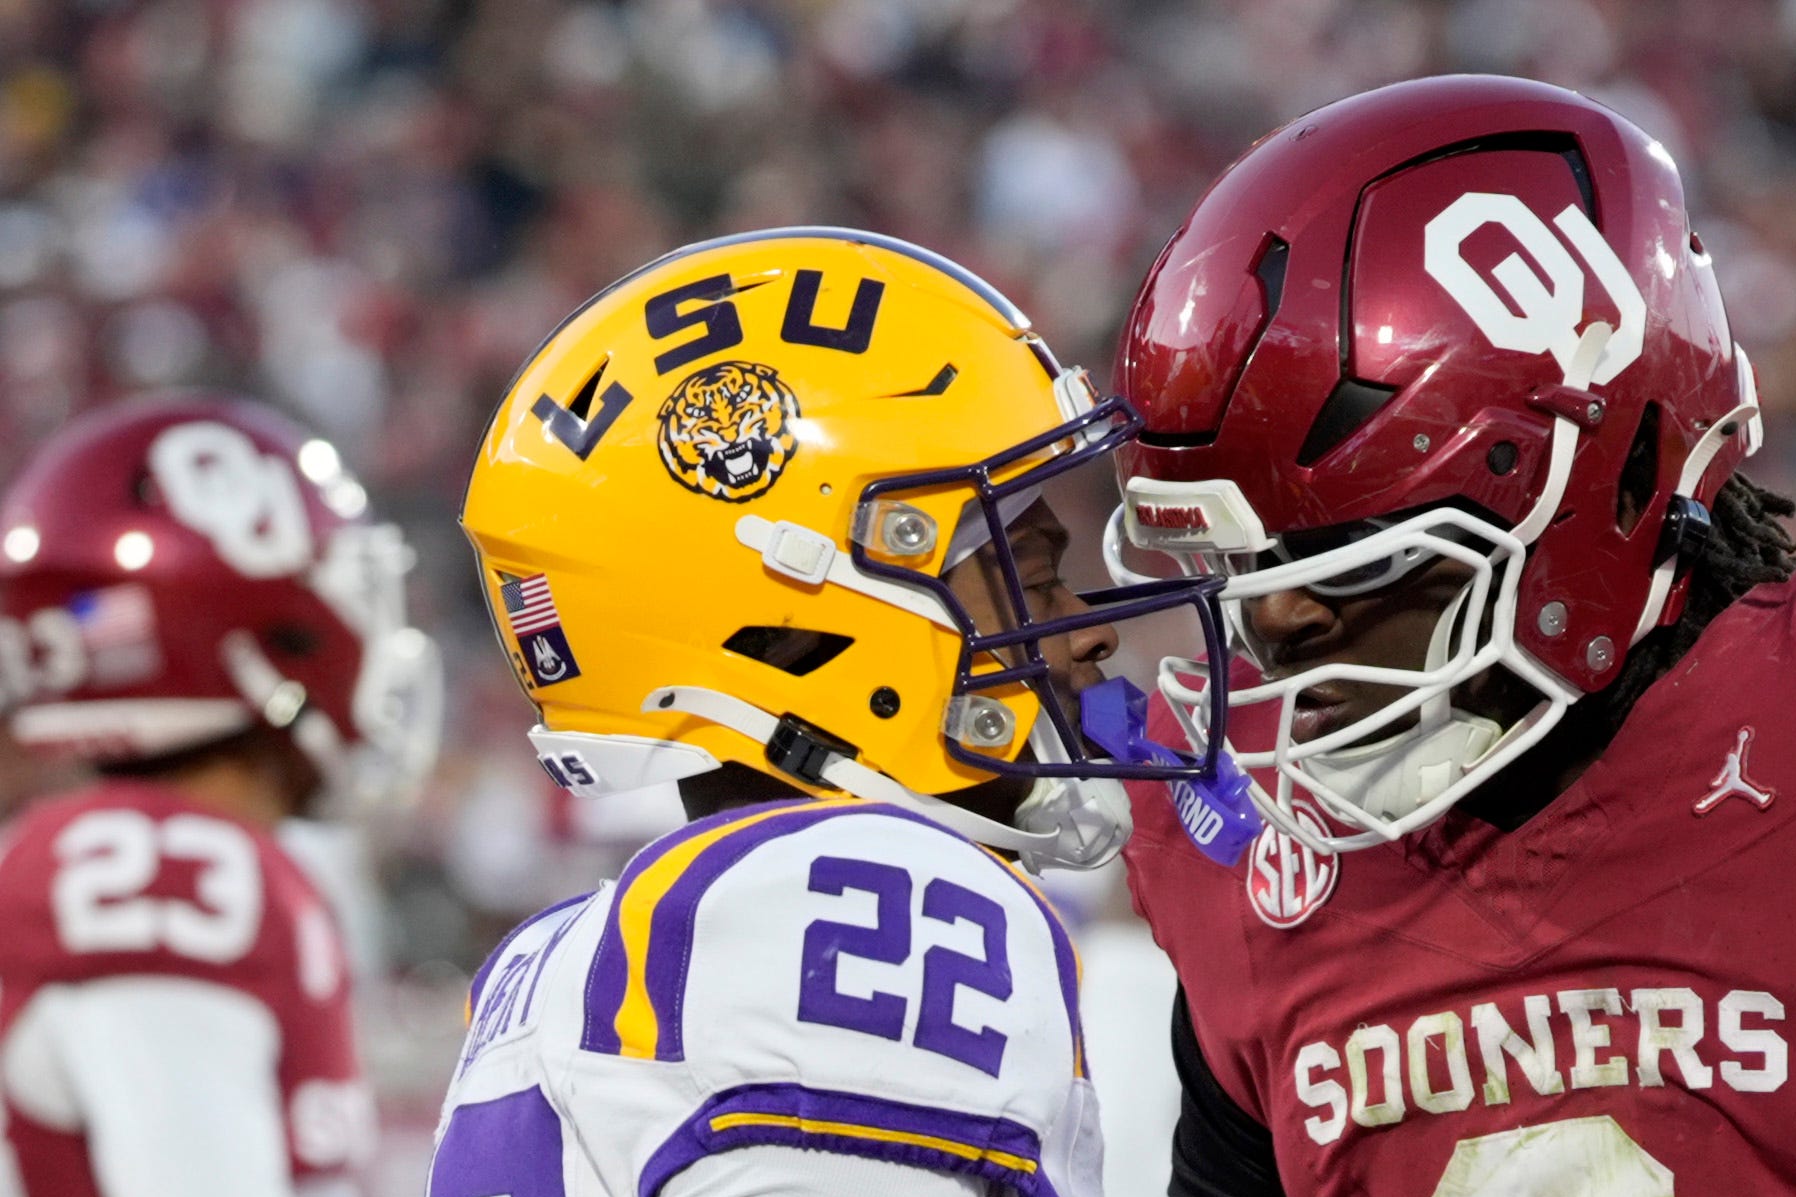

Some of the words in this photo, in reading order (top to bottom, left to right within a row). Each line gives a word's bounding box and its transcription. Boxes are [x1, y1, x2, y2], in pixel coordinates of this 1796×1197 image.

[532, 269, 885, 461] LSU
[1424, 192, 1648, 386] OU
[53, 810, 264, 964] 23
[1253, 810, 1330, 919] SEC
[798, 854, 1013, 1079] 22
[1296, 987, 1789, 1145] SOONERS
